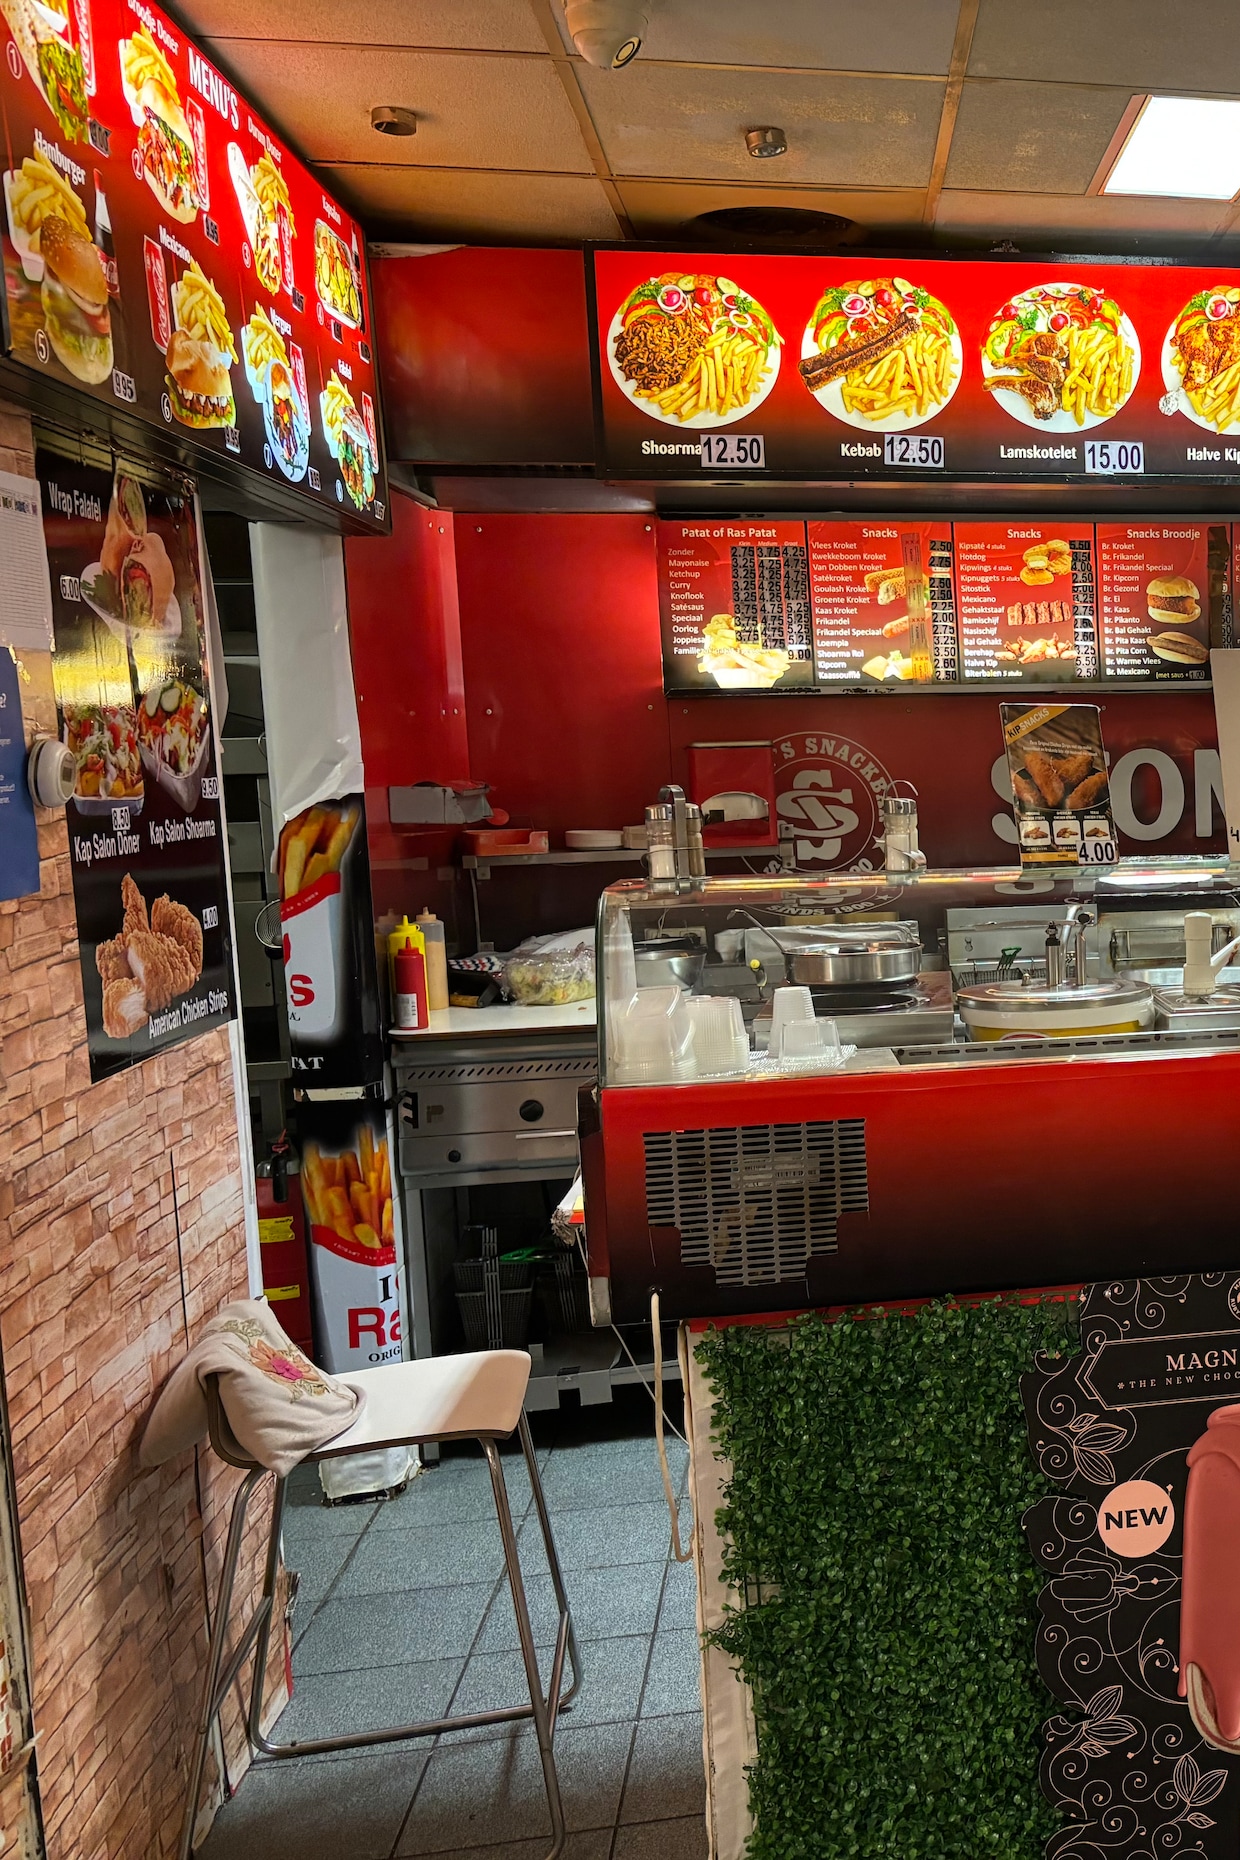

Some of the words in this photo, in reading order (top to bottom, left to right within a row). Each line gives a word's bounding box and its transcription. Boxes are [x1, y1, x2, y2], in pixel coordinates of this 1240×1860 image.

[188, 47, 240, 131] MENU'S
[34, 128, 85, 185] Hamburger
[159, 224, 191, 264] Mexicano
[642, 440, 702, 455] Shoarma
[703, 437, 761, 463] 12.50
[841, 443, 881, 458] Kebab
[887, 436, 942, 464] 12.50
[1000, 445, 1076, 459] Lamskotelet
[1187, 448, 1220, 461] Halve
[1088, 444, 1140, 469] 15.00
[48, 481, 72, 520] Wrap
[73, 489, 101, 522] Falafel
[682, 528, 711, 537] Patat
[713, 528, 724, 537] of
[727, 528, 745, 537] Ras
[749, 528, 776, 537] Patat
[863, 528, 898, 538] Snacks
[1008, 529, 1041, 538] Snacks
[1127, 529, 1160, 538] Snacks
[1163, 529, 1200, 539] Broodje
[731, 547, 754, 557] 2.75
[757, 547, 780, 557] 3.75
[782, 547, 805, 557] 4.25
[669, 571, 700, 579] Ketchup
[960, 564, 991, 572] Kipwings
[813, 574, 852, 582] Satékroket
[61, 578, 79, 599] 6.00
[670, 582, 690, 590] Curry
[670, 592, 704, 600] Knoflook
[671, 603, 704, 611] Satésaus
[672, 614, 703, 622] Speciaal
[1008, 708, 1049, 738] KIPSNACKS
[202, 781, 217, 797] 9.50
[113, 809, 129, 828] 8.50
[149, 821, 164, 849] Kap
[165, 819, 185, 842] Salon
[186, 817, 216, 840] Shoarma
[74, 836, 91, 867] Kap
[93, 833, 117, 860] Salon
[118, 830, 140, 855] Döner
[1079, 843, 1114, 862] 4.00
[204, 909, 217, 927] 4.00
[149, 1009, 181, 1039] American
[182, 997, 208, 1024] Chicken
[208, 988, 228, 1014] Strips
[1129, 1379, 1156, 1389] THE
[1166, 1375, 1194, 1386] NEW
[1104, 1505, 1168, 1531] NEW
